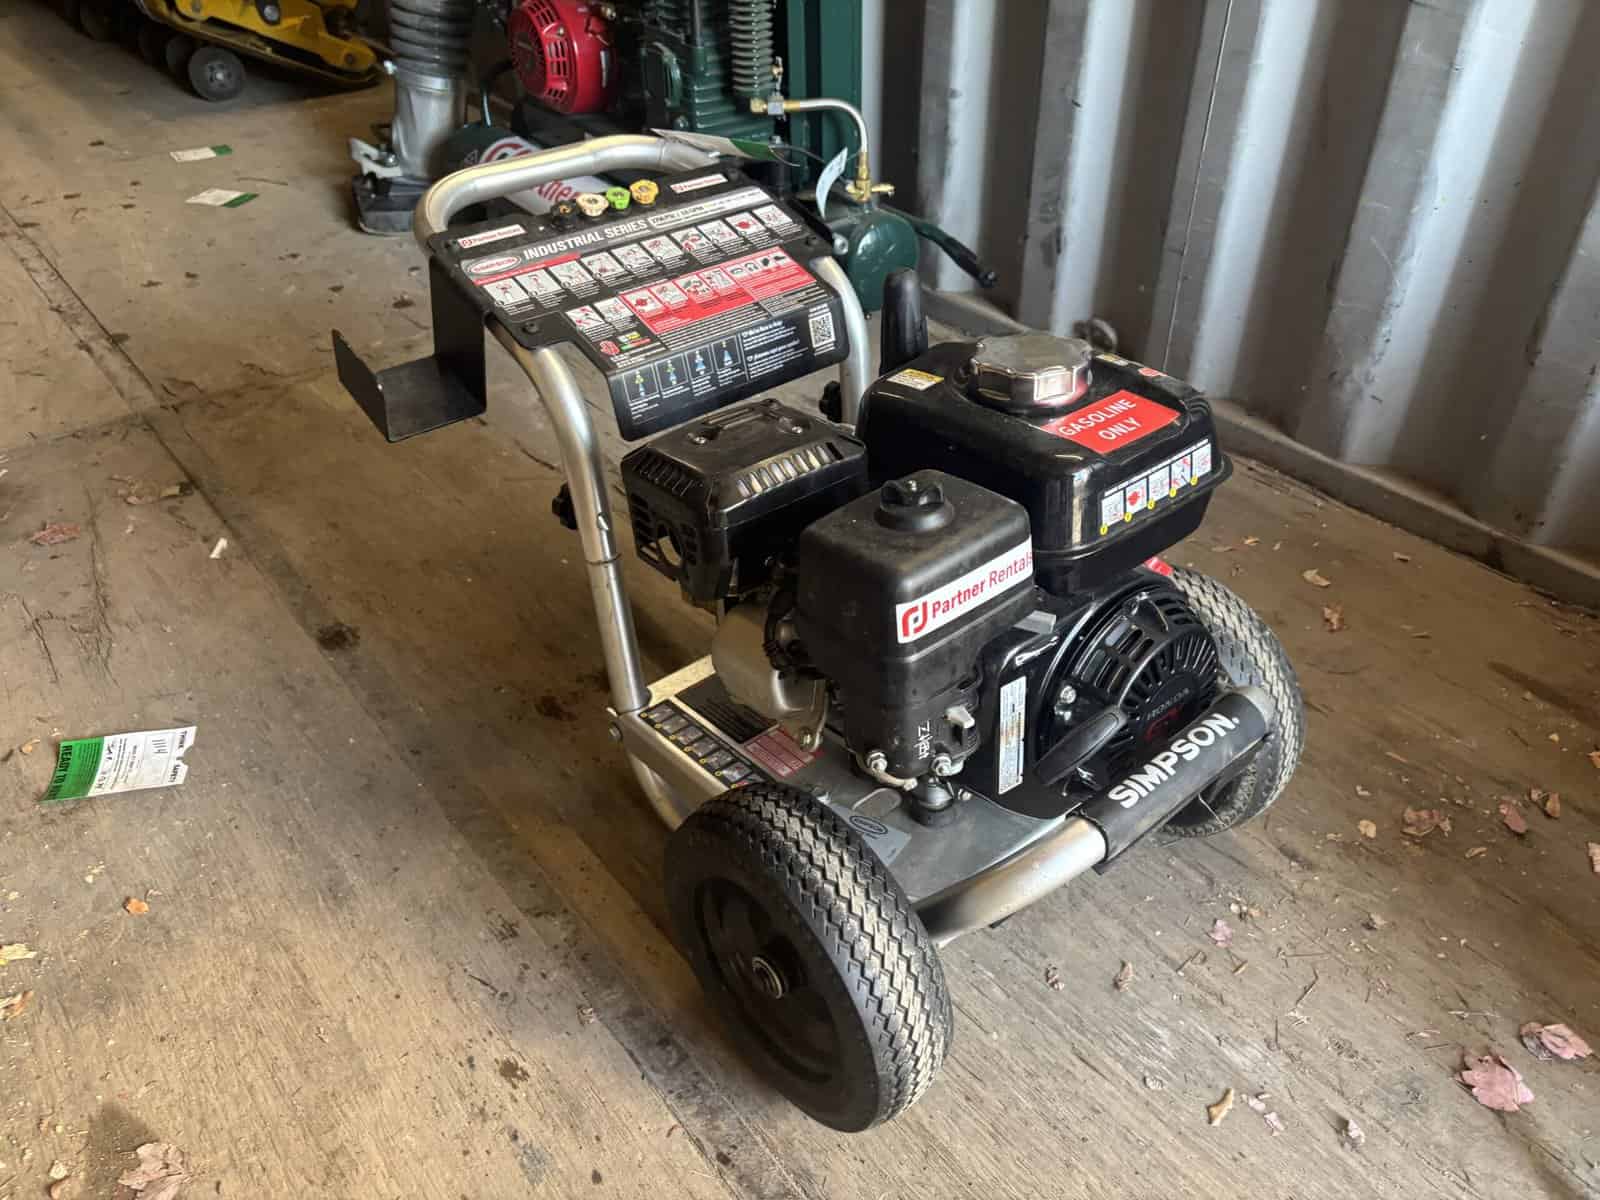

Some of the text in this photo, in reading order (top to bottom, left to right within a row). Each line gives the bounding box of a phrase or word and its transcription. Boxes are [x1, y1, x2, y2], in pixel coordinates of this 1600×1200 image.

[523, 230, 604, 260] INDUSTRIAL
[604, 219, 647, 239] SERIES
[1059, 399, 1136, 435] GASOLINE
[1098, 416, 1142, 440] ONLY
[932, 579, 985, 618] Partner
